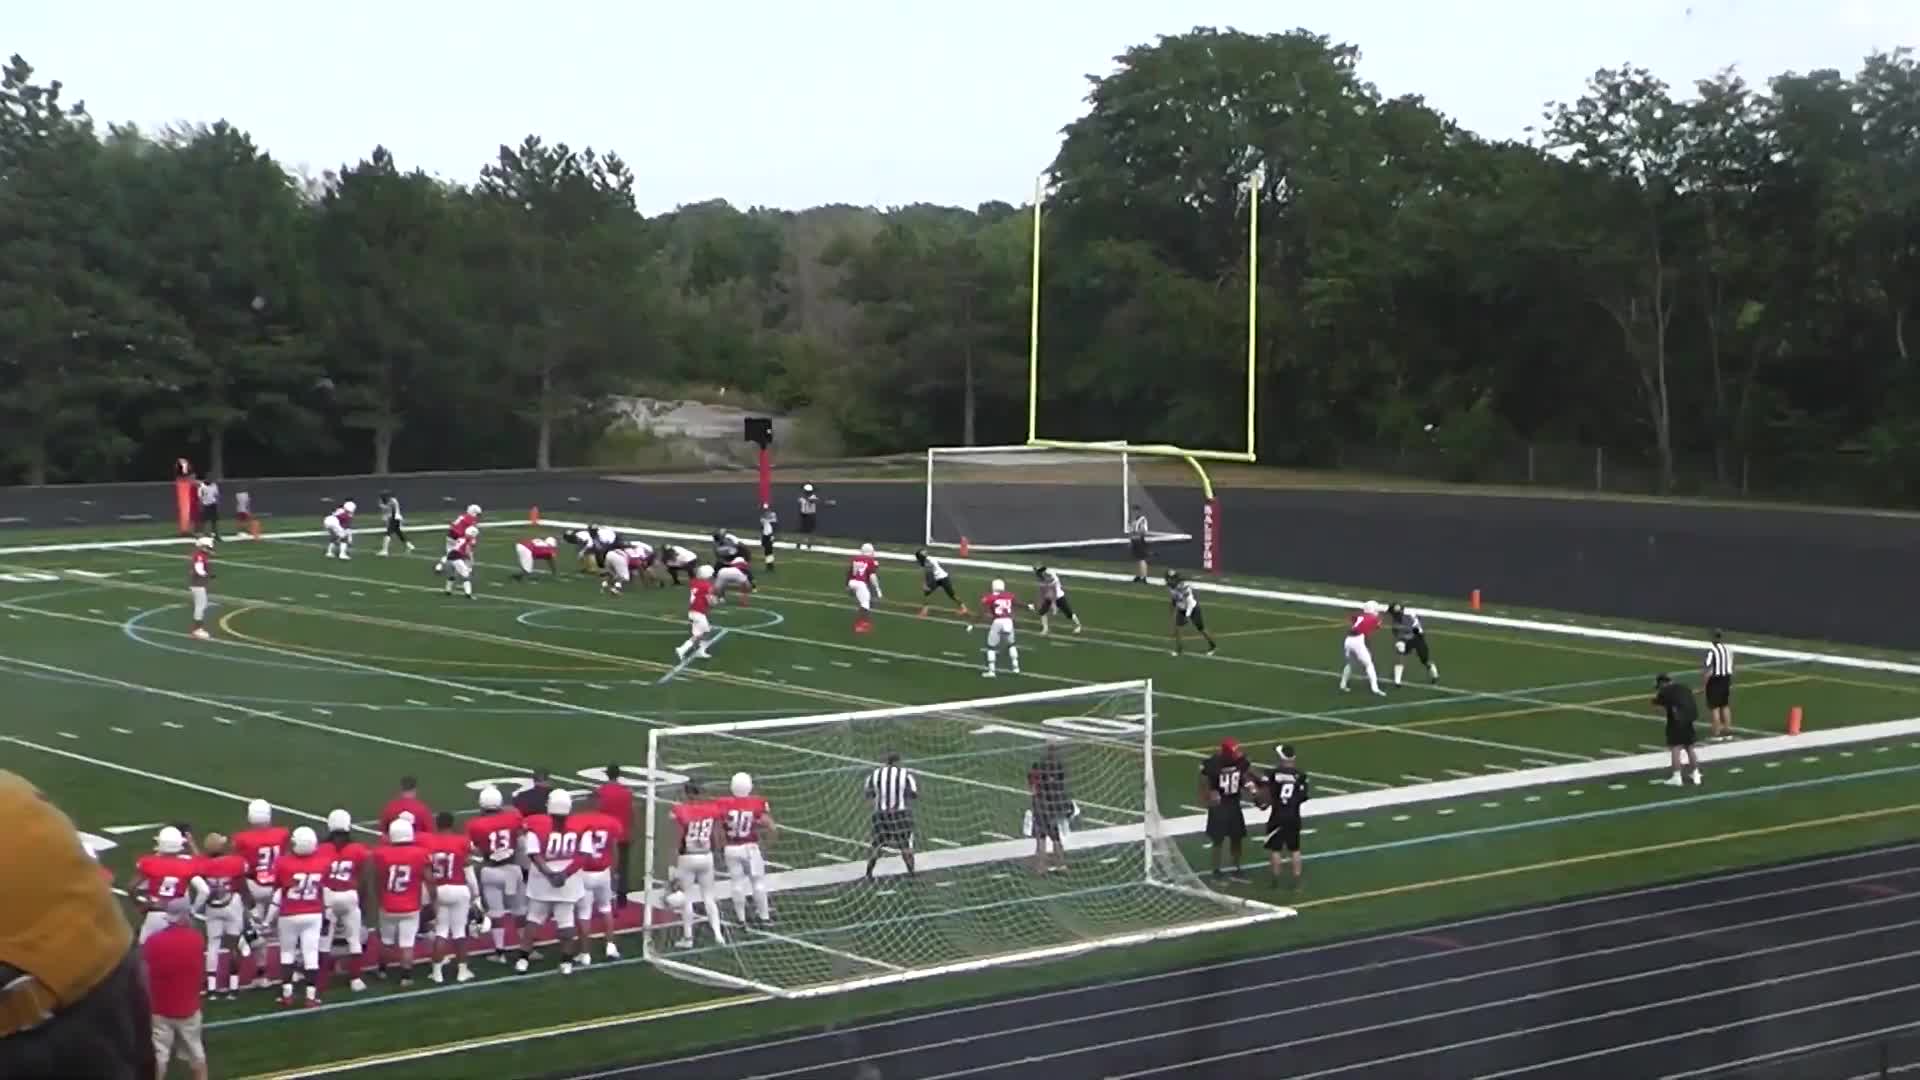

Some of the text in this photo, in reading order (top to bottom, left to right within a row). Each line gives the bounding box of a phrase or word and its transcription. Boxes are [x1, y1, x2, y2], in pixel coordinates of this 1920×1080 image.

[1203, 504, 1213, 569] RALSTON
[1219, 771, 1240, 794] 48
[545, 831, 578, 859] 00
[387, 864, 411, 892] 12
